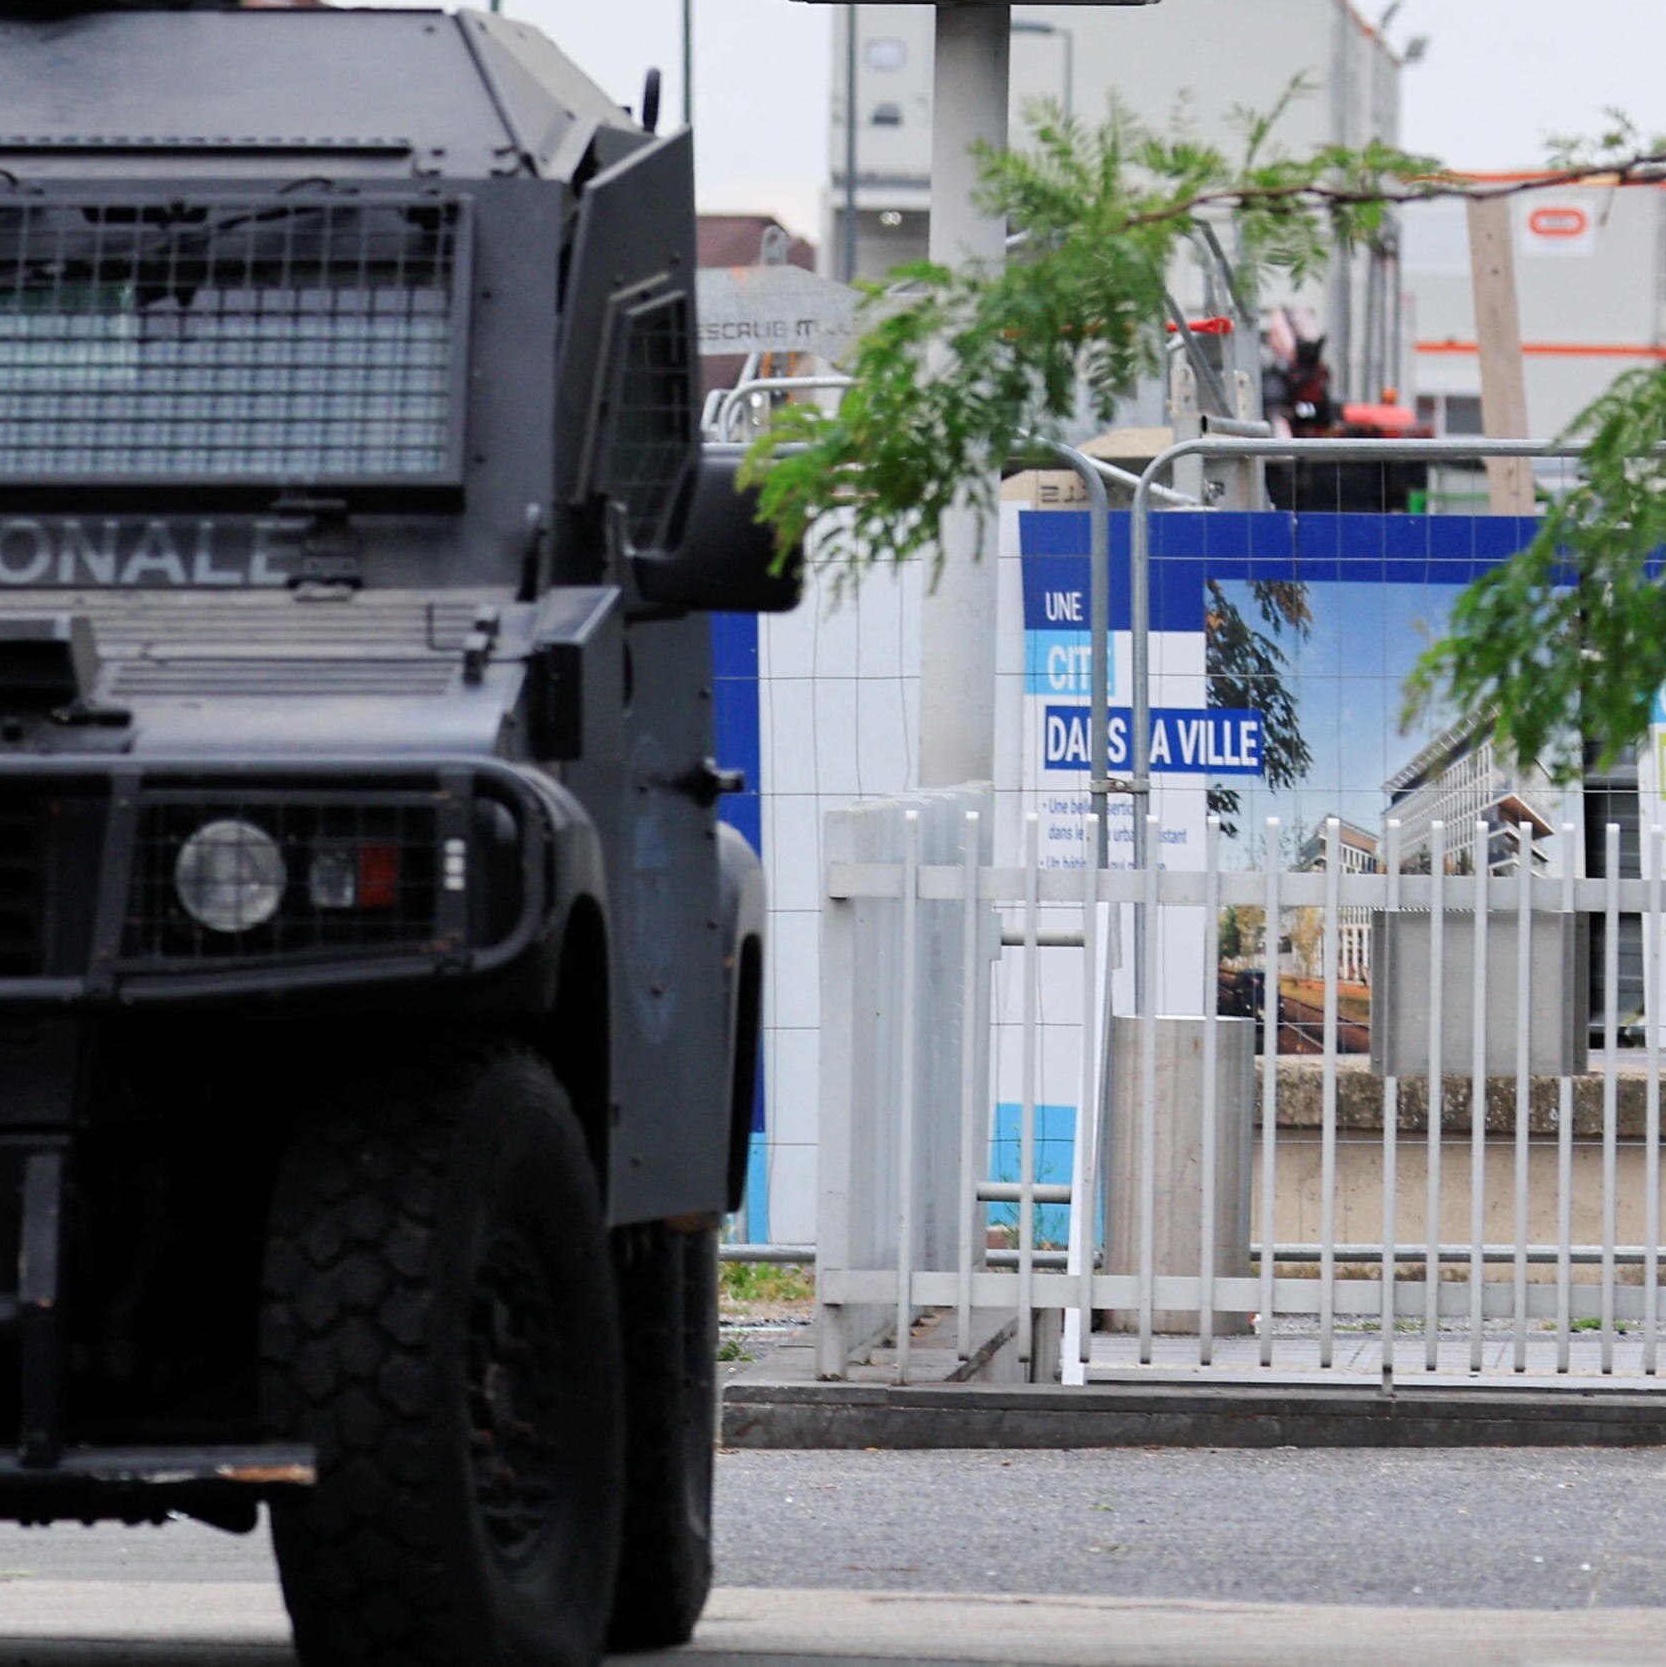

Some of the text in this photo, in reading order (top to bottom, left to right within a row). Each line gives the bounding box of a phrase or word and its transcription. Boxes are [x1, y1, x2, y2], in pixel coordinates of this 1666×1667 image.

[1045, 591, 1083, 622] UNE
[1047, 644, 1111, 690] CIT
[1176, 719, 1258, 767] VILLE
